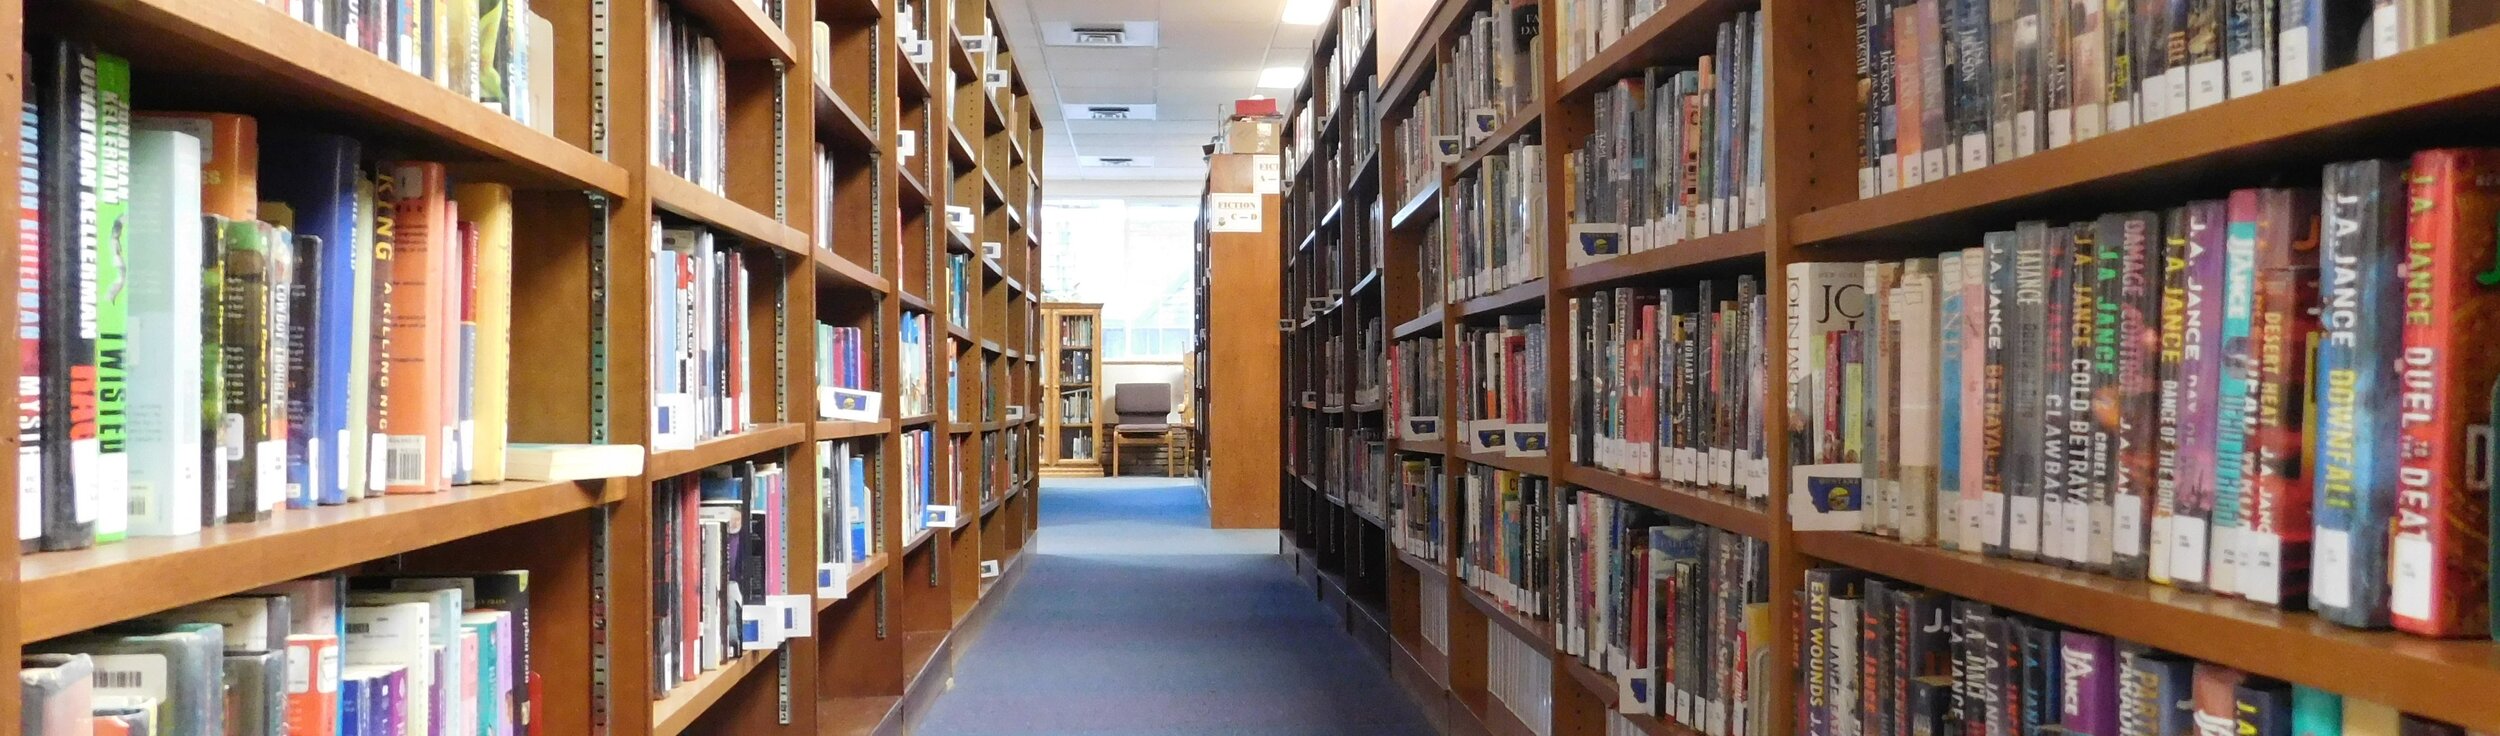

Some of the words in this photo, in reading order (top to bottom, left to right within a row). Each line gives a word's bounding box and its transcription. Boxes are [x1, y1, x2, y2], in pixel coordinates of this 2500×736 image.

[1856, 24, 1868, 75] JACKSON
[1880, 51, 1891, 102] JACKSON
[79, 55, 97, 185] JONATHAN
[102, 91, 119, 203] KELLERMAN
[117, 101, 130, 200] JONATHAN
[1259, 163, 1280, 171] FICT
[375, 173, 394, 262] KING
[1217, 201, 1256, 209] FICTION
[80, 191, 97, 339] KELLERMAN
[384, 282, 392, 294] A
[2121, 219, 2146, 297] DAMAGE
[2407, 238, 2434, 325] JANCE
[274, 284, 288, 339] COWBOY
[1788, 276, 1799, 342] JOHN
[1988, 285, 2002, 349] JANCE
[2071, 282, 2092, 347] JANCE
[2161, 285, 2184, 363] JANCE
[2185, 275, 2204, 361] JANCE
[2332, 254, 2357, 348] JANCE
[380, 302, 392, 387] KILLING
[1685, 340, 1694, 385] MORIARTY
[2094, 294, 2119, 374] JANCE
[2262, 312, 2282, 374] DESERT
[71, 365, 97, 441] RAG
[100, 332, 127, 454] TWISTED
[273, 347, 287, 408] TROUBLE
[1788, 346, 1799, 407] JAKES
[2070, 358, 2091, 411] COLD
[2160, 380, 2179, 427] DANCE
[2262, 382, 2279, 427] HEAT
[2402, 347, 2433, 427] DUEL
[379, 394, 388, 430] NIG
[2160, 427, 2176, 443] OF
[2323, 369, 2356, 509] DOWNFALL
[2044, 394, 2062, 502] CLAWBAC
[2067, 420, 2089, 505] BETRAYA
[2093, 431, 2108, 477] CRUEL
[2118, 461, 2131, 496] JAN
[2159, 447, 2176, 475] THE
[2092, 482, 2107, 505] INT
[2157, 477, 2175, 515] BONE
[2258, 489, 2273, 534] JANC
[2399, 467, 2431, 541] DEAT
[1810, 581, 1823, 623] EXIT
[1809, 627, 1823, 706] WOUNDS
[1985, 682, 1999, 736] JANC
[2025, 688, 2039, 736] JANC
